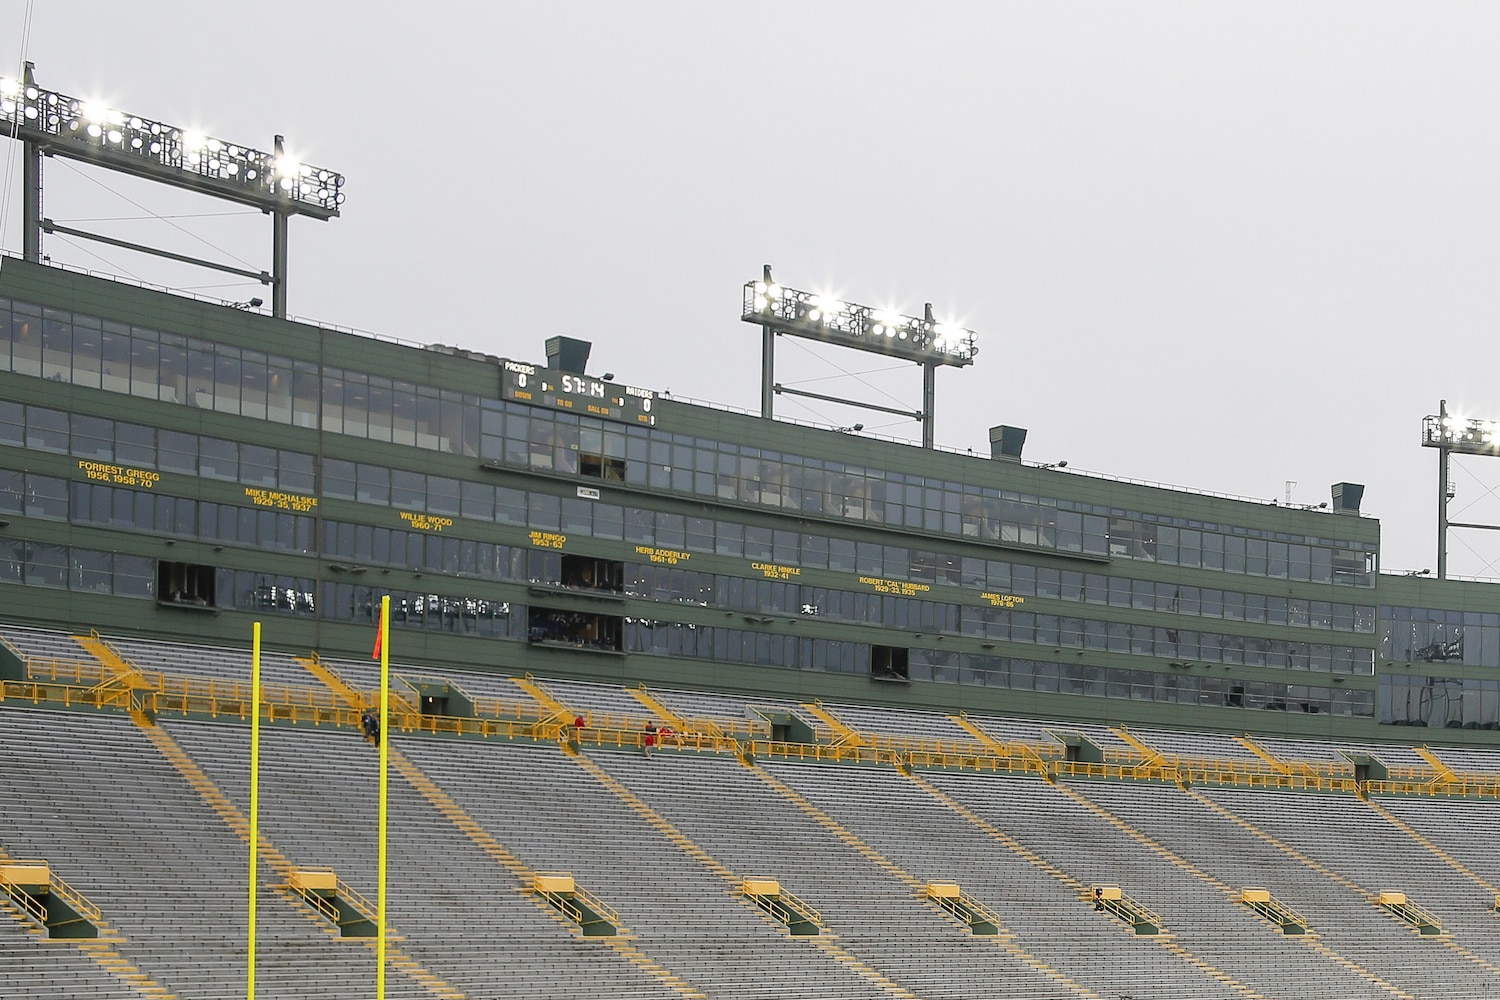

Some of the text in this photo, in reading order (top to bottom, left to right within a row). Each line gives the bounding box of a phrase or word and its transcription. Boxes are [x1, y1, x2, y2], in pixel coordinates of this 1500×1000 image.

[504, 361, 535, 375] PACKERS
[518, 374, 527, 388] 0
[562, 375, 605, 398] 57:14
[626, 386, 654, 400] RAIDERS
[643, 398, 651, 413] 0
[79, 460, 160, 482] FORREST GREGG
[86, 470, 110, 483] 1956,
[245, 487, 318, 507] MIKE MICHALSKE
[292, 502, 311, 512] 1937
[400, 512, 453, 527] WILLIE WOOD
[528, 531, 566, 543] JIM RINGO
[636, 546, 691, 561] HERB ADDERLEY
[752, 562, 800, 576] CLARKE HINKLE
[859, 576, 884, 586] ROBERT
[901, 582, 930, 592] HUBBARD
[980, 592, 1024, 604] JAMES LOFTON
